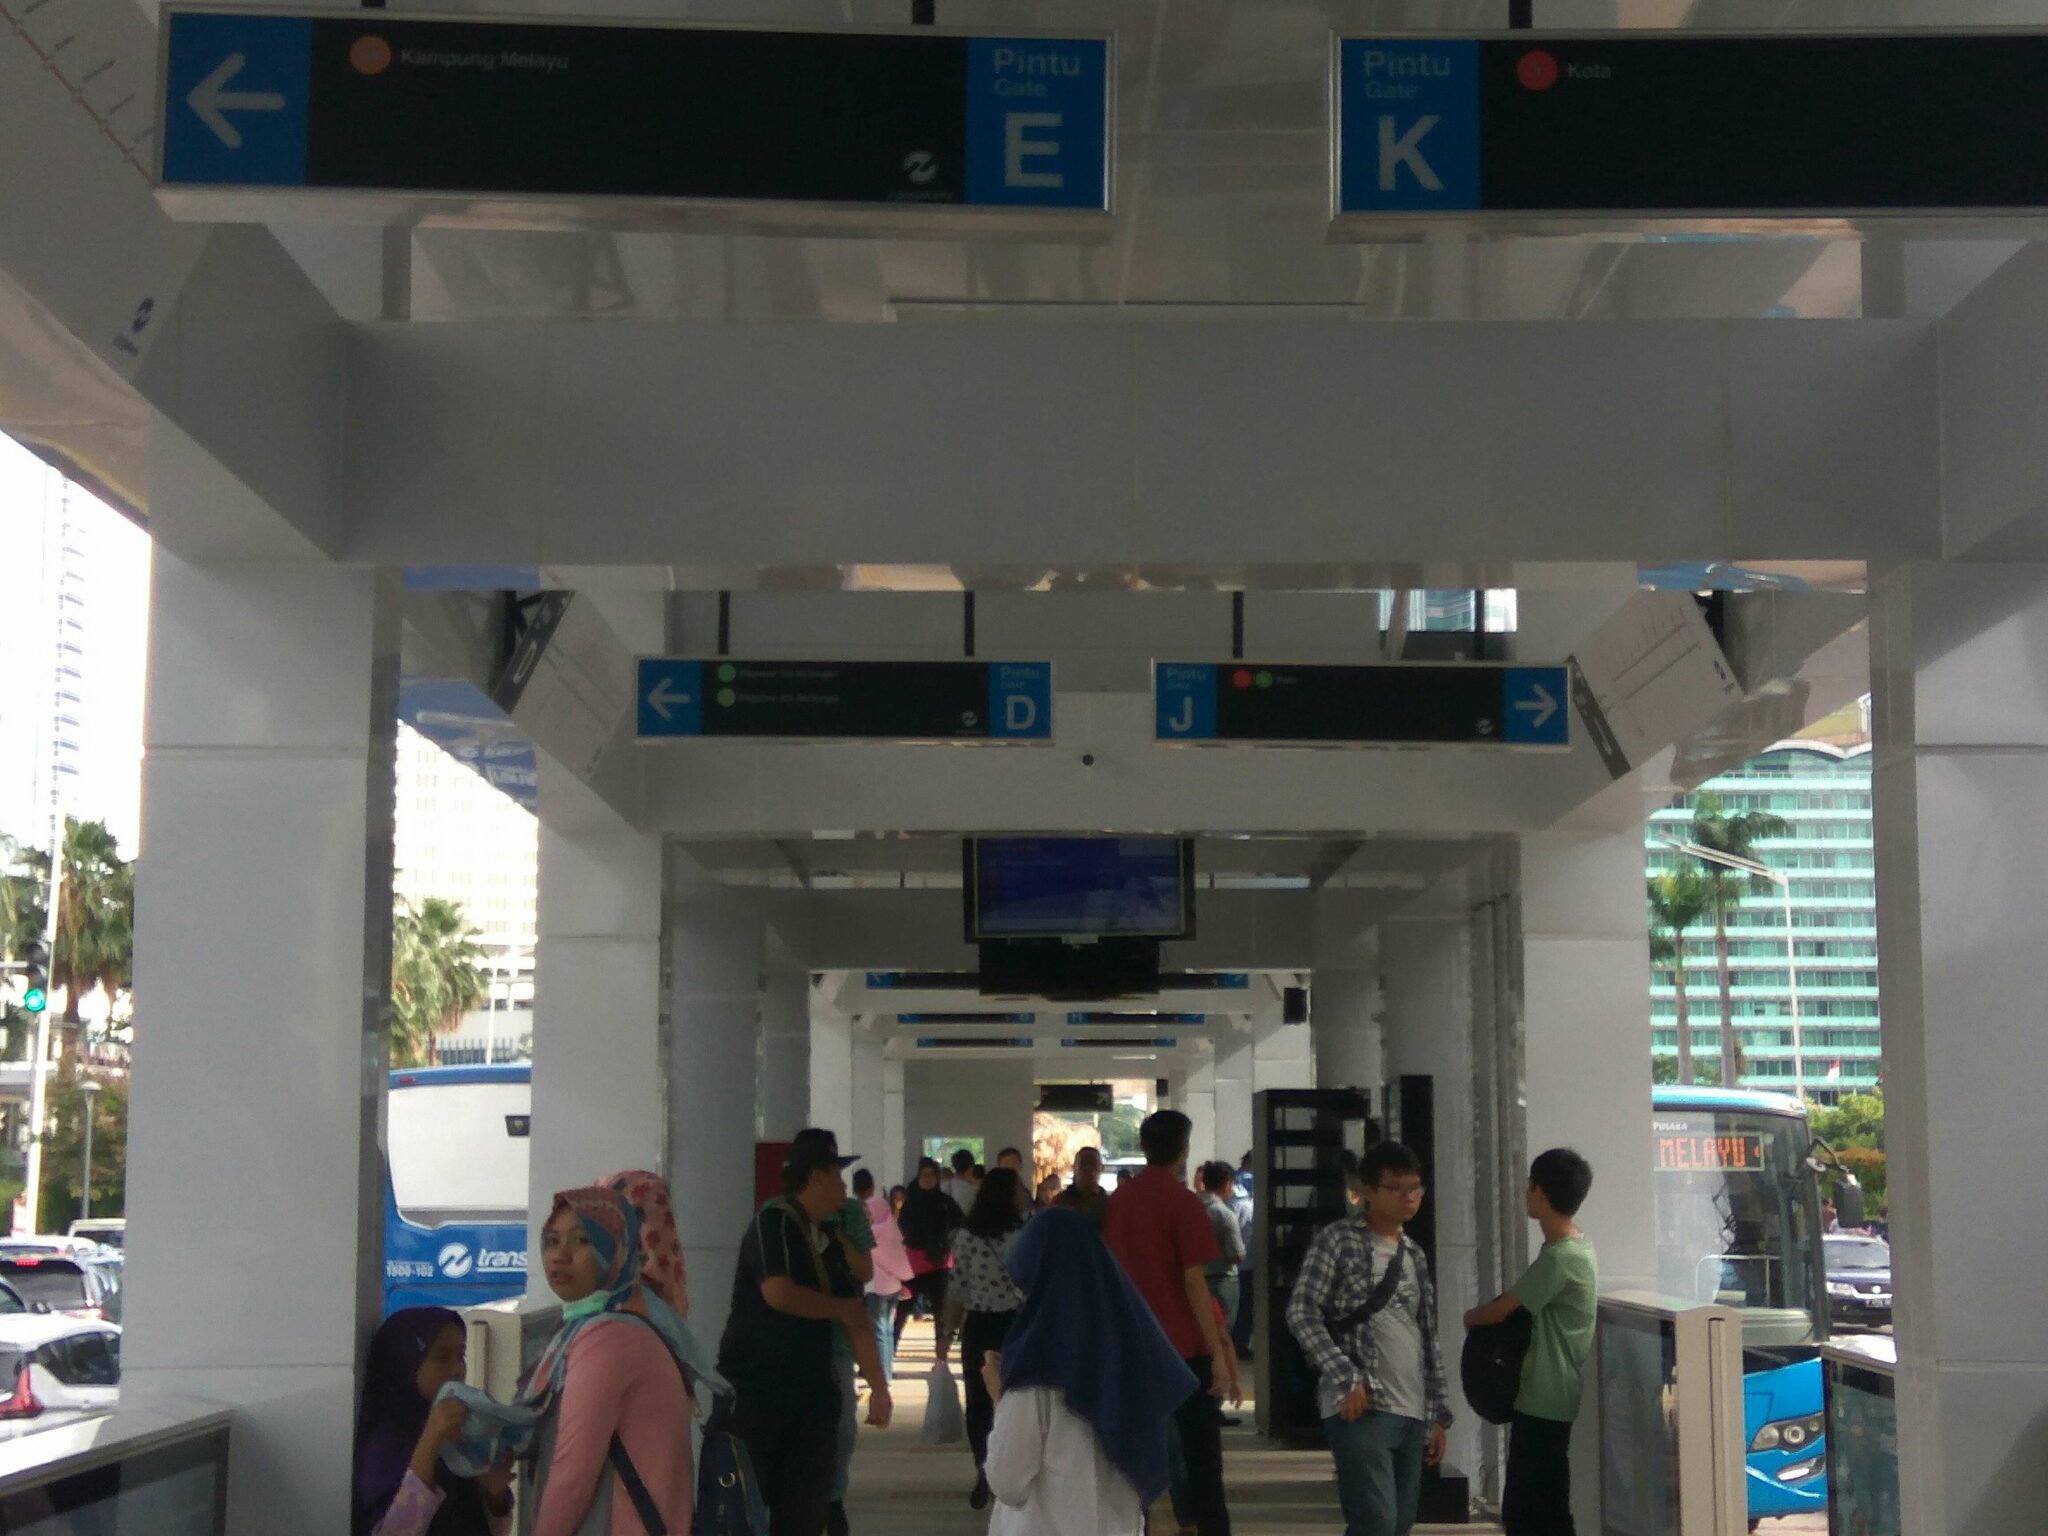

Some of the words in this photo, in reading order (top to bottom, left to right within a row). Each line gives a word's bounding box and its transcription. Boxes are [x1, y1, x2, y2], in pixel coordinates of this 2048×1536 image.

[400, 49, 494, 70] Kampung
[502, 51, 569, 71] Melayu
[994, 48, 1081, 76] Pintu
[1363, 50, 1451, 77] Pintu
[1568, 63, 1612, 80] Kota
[994, 78, 1047, 96] Gate
[1365, 80, 1417, 99] Gate
[1004, 112, 1064, 188] E
[1377, 115, 1445, 192] K
[1166, 667, 1206, 681] Pintu
[1006, 695, 1036, 730] D
[1169, 696, 1193, 732] J
[1659, 1136, 1746, 1168] MELAYU
[478, 1248, 528, 1267] trans
